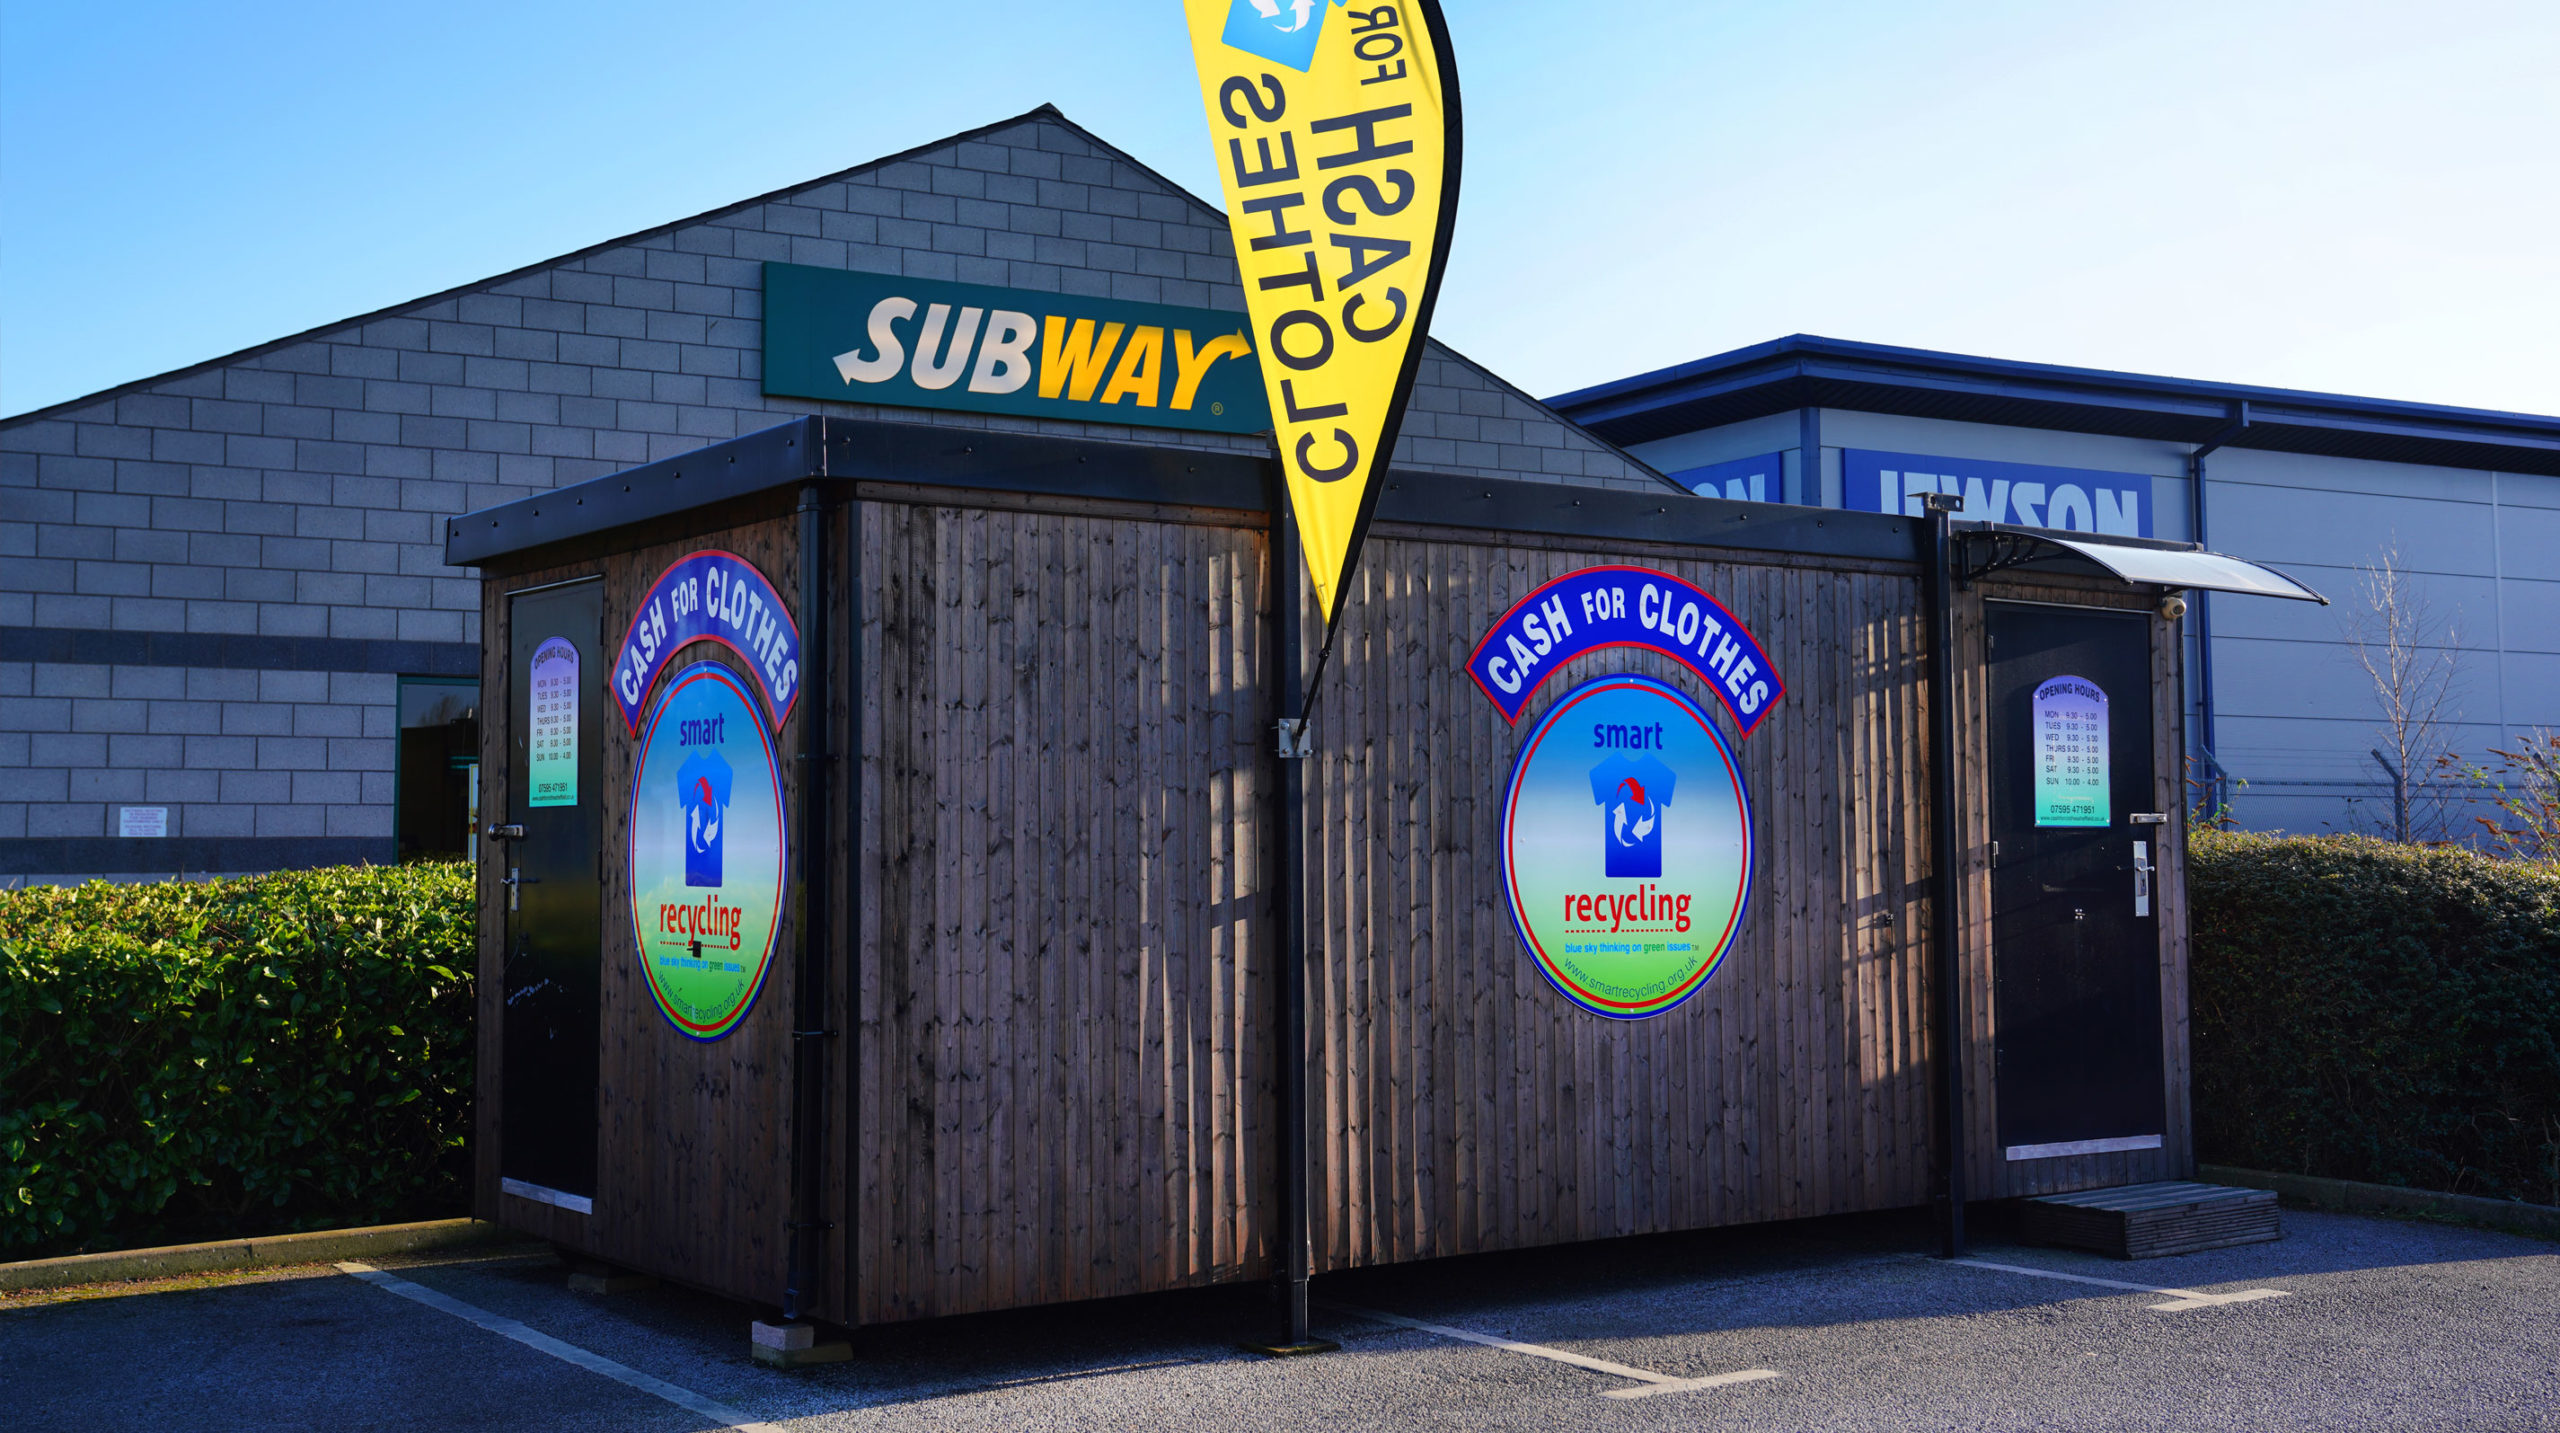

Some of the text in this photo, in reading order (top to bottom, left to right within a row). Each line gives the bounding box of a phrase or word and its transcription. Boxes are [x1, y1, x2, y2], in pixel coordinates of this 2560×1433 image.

[832, 296, 1252, 411] SUBWAY
[621, 566, 798, 706] CASH FOR CLOTHES
[535, 646, 574, 670] OPENING HOURS
[1487, 583, 1769, 715] CASH FOR CLOTHES
[538, 680, 546, 688] MON
[2040, 683, 2099, 703] OPENING HOURS
[538, 691, 547, 700] TUES
[537, 704, 546, 712] WED
[537, 717, 550, 725] THURS
[680, 712, 724, 746] smart
[1594, 722, 1663, 750] smart
[539, 784, 551, 792] 07595
[2050, 805, 2094, 814] 07595 471951
[1564, 884, 1691, 933] recycling
[660, 894, 742, 950] recycling
[1565, 943, 1582, 953] blue
[1584, 943, 1597, 954] sky
[1600, 942, 1630, 954] thinking
[1644, 944, 1664, 954] green
[1667, 941, 1691, 951] issues
[659, 955, 670, 966] blue
[671, 957, 679, 969] sky
[681, 956, 700, 972] thinking
[702, 960, 708, 969] on
[709, 961, 723, 972] green
[724, 961, 740, 972] issues
[1565, 956, 1698, 1000] www.smartrecycling.org.uk
